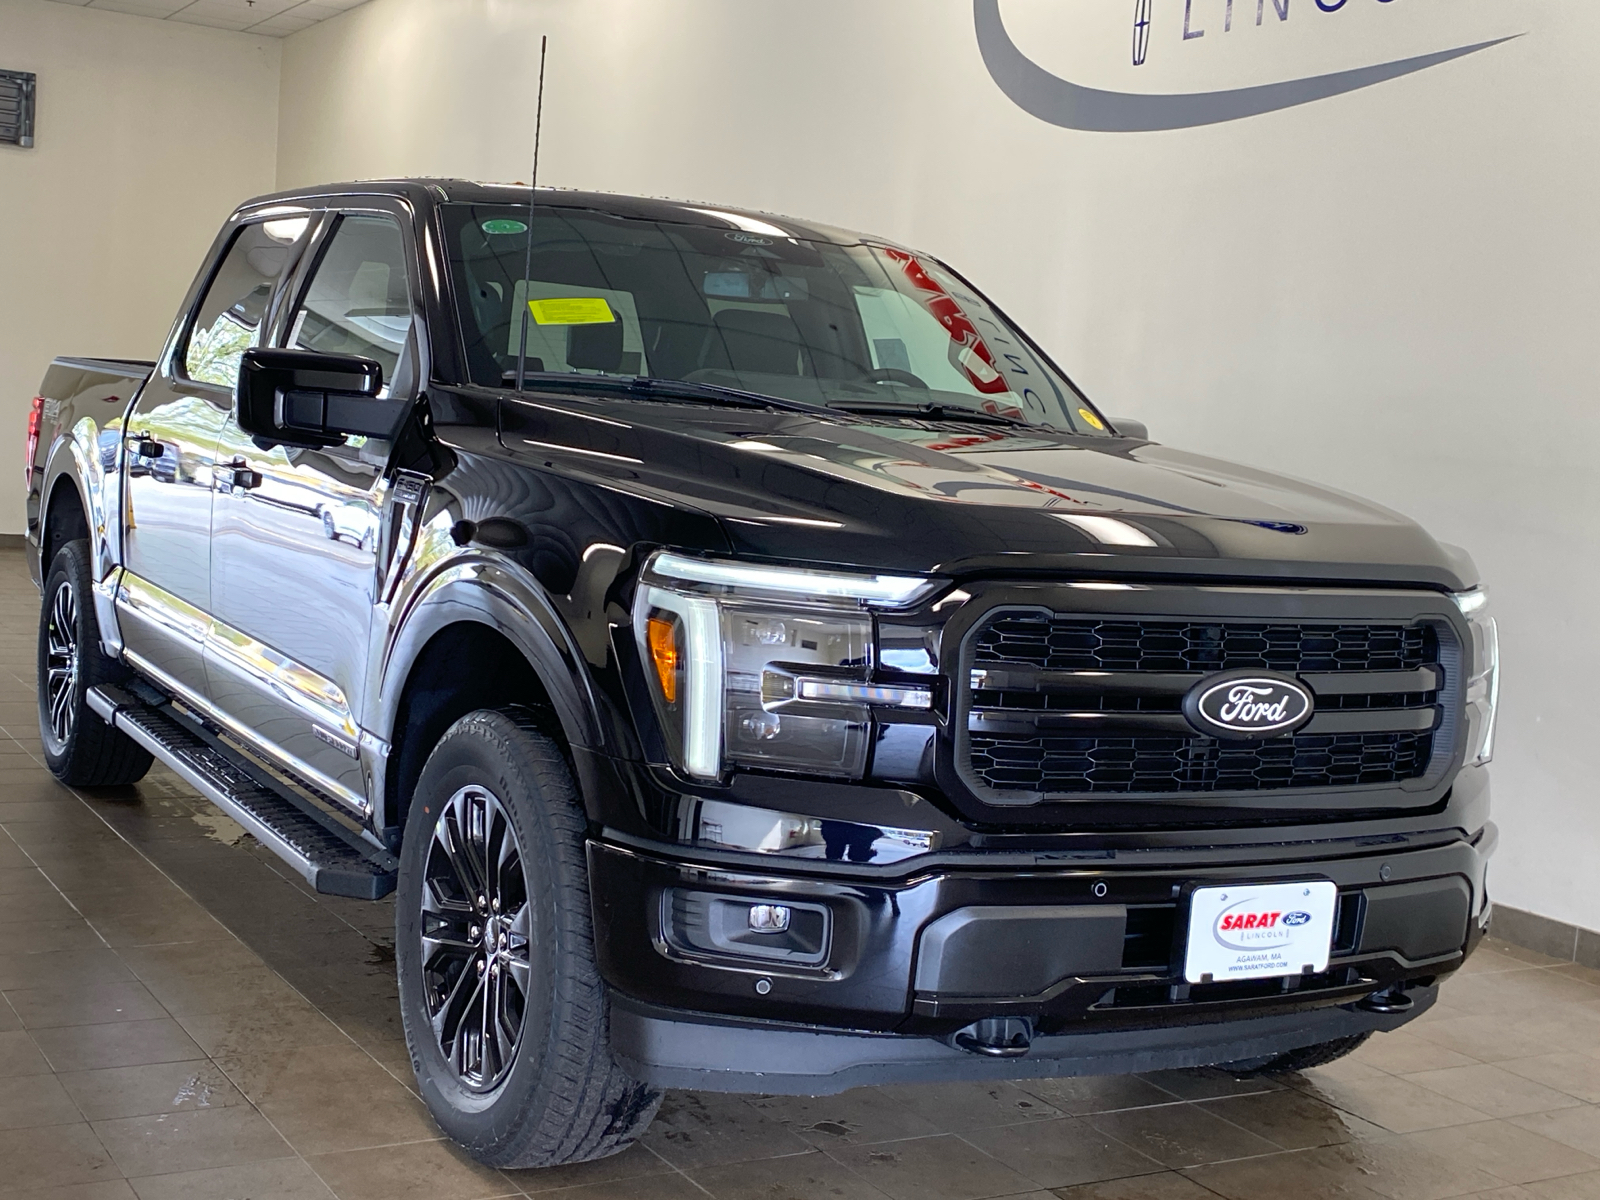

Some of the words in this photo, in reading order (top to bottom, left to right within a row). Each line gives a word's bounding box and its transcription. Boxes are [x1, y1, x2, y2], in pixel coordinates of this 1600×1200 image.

[734, 233, 765, 244] Ford
[1220, 685, 1289, 721] Ford
[1220, 911, 1281, 930] SARAT
[1286, 912, 1306, 924] Ford
[1246, 931, 1283, 940] LINCOLN
[1228, 962, 1288, 972] WWW.SARATFORD.COM
